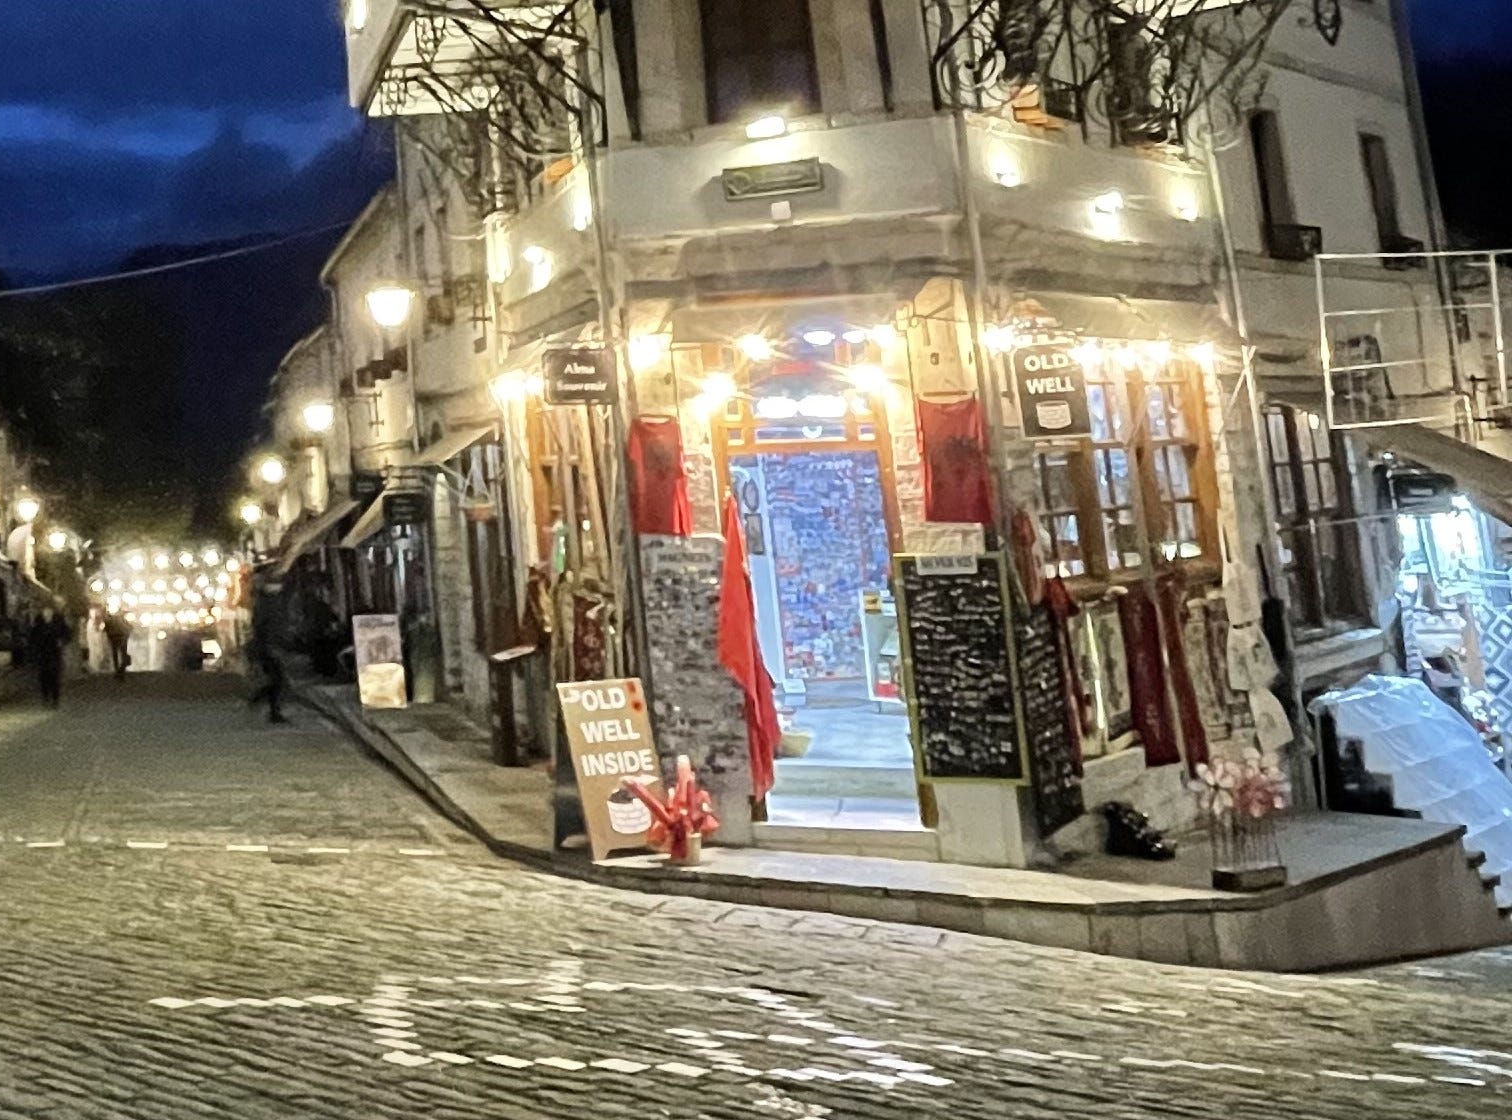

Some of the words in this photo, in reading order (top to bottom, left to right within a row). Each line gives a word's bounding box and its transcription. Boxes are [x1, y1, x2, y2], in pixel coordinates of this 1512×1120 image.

[1024, 352, 1069, 372] OLD
[1025, 376, 1075, 395] WELL
[581, 686, 626, 712] OLD
[580, 718, 640, 744] WELL
[581, 748, 654, 776] INSIDE
